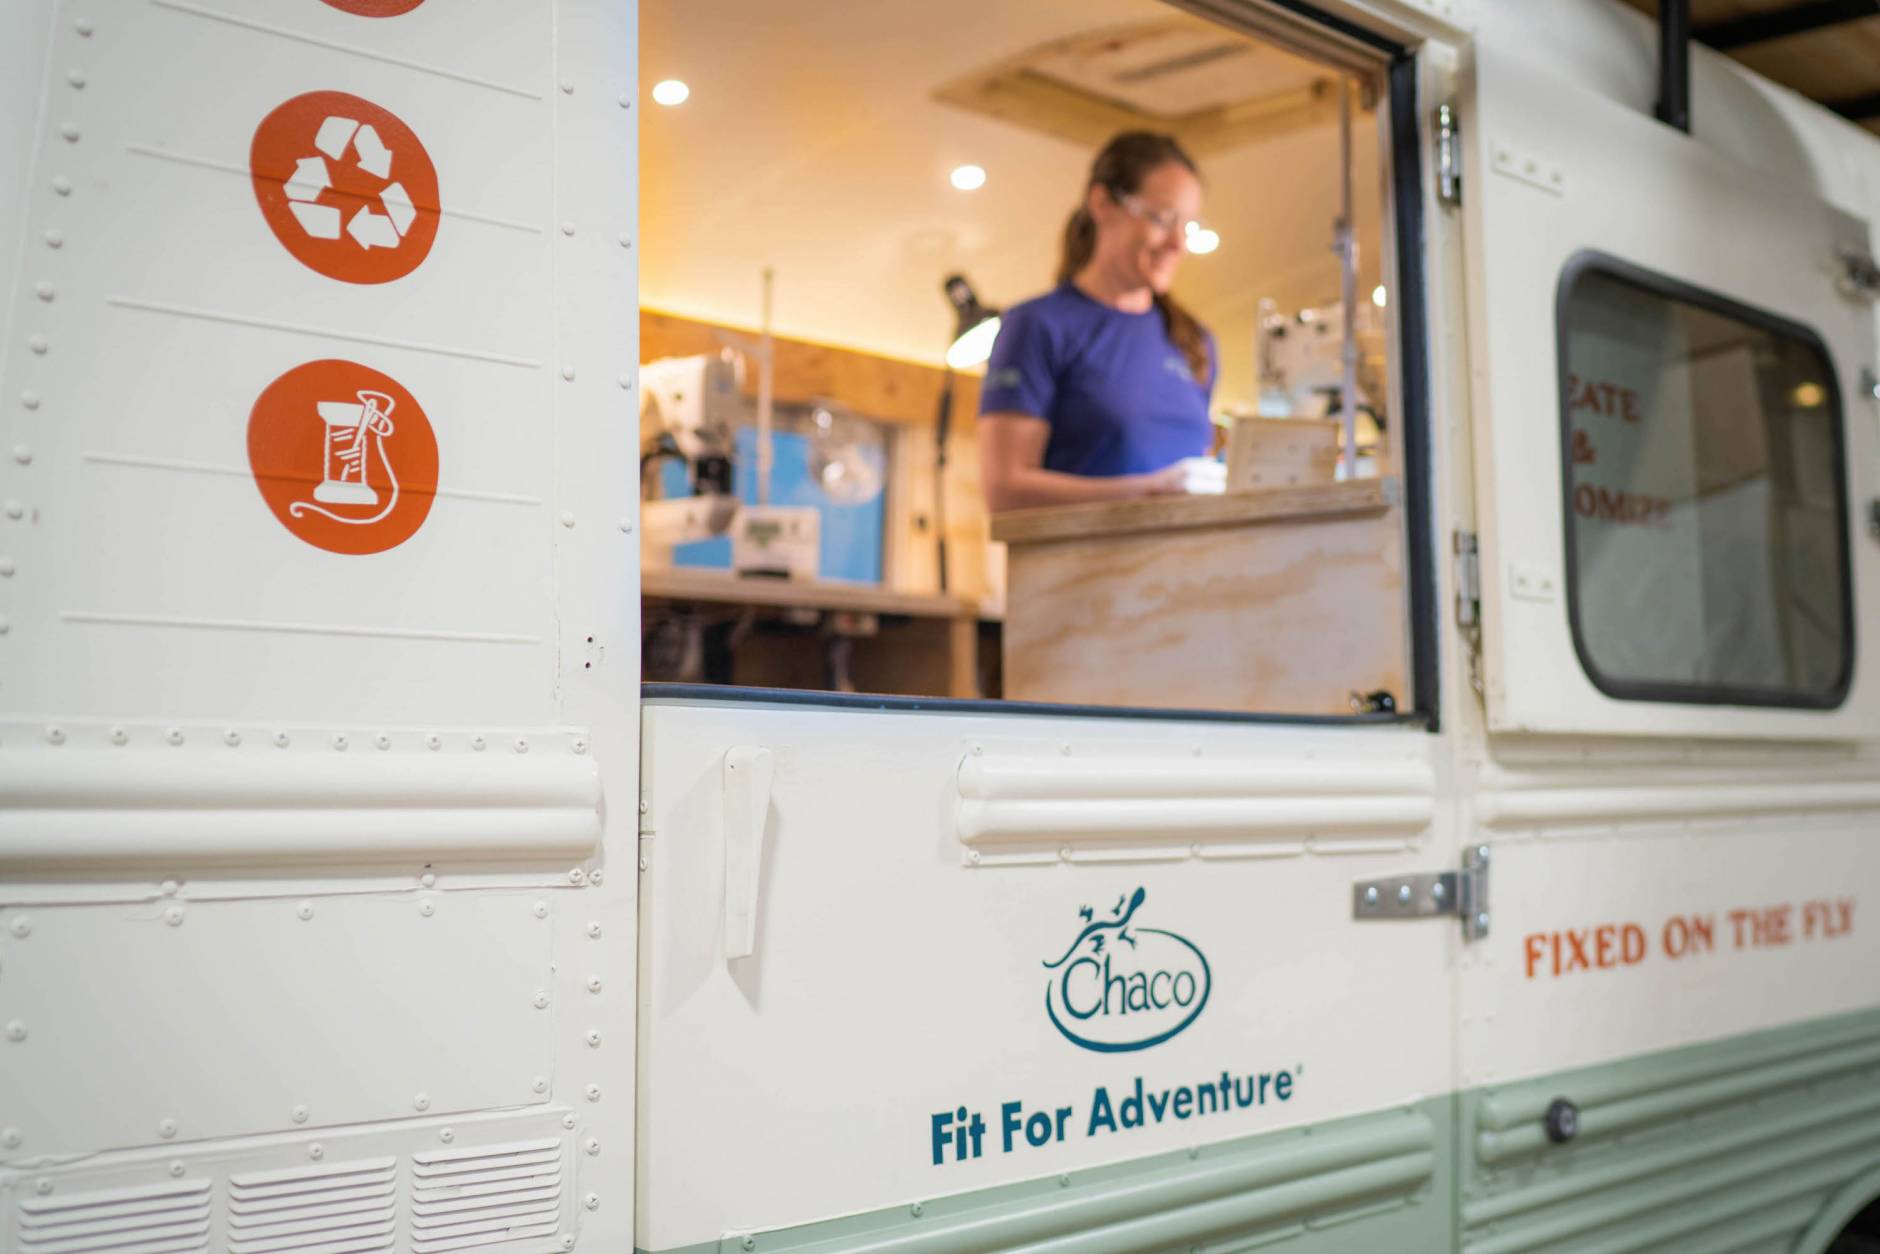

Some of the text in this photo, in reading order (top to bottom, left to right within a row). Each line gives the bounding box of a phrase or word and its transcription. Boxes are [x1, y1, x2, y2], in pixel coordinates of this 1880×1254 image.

[1523, 896, 1857, 979] FIXED ON THE FLY
[1061, 953, 1196, 1020] Chaco
[931, 1069, 1294, 1166] Fit For Adventure
